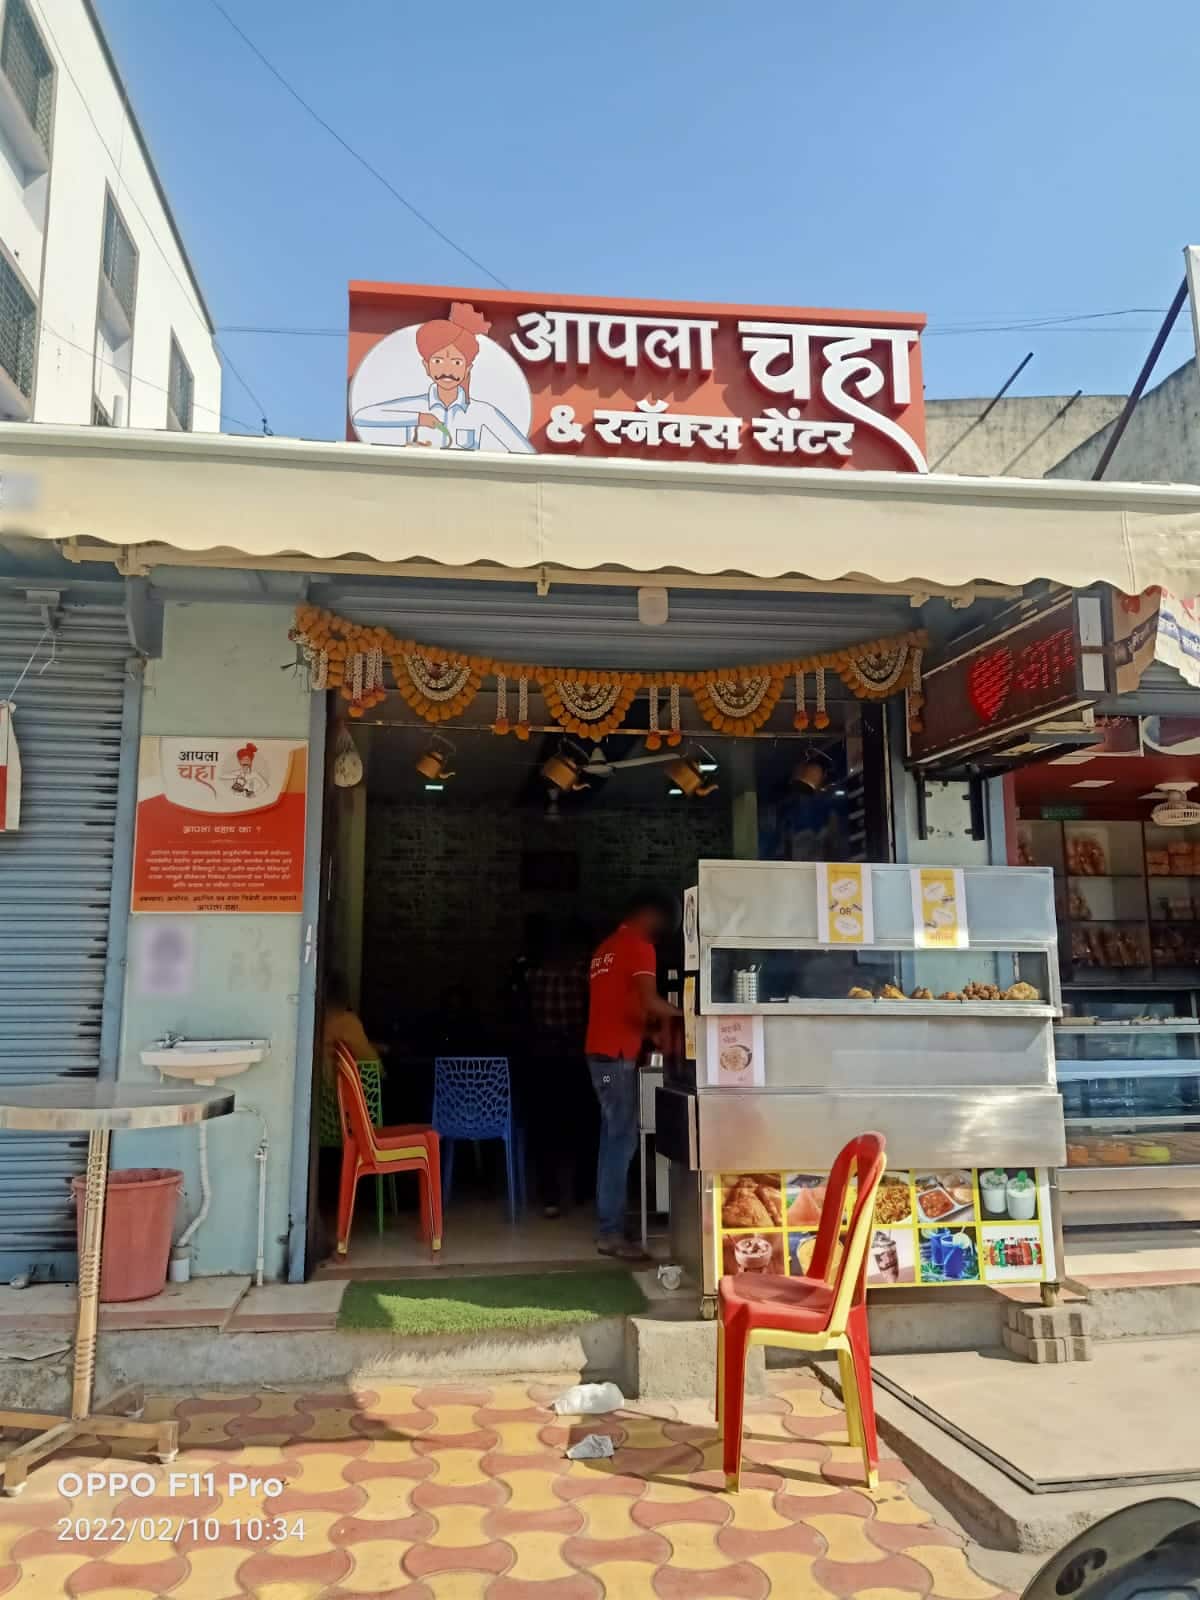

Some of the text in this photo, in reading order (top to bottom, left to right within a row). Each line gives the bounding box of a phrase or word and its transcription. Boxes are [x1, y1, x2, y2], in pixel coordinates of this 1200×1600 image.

[510, 311, 929, 474] आपला चहा
[546, 400, 855, 456] & स्नॅक्स सेंटर
[178, 751, 219, 762] आपला
[176, 764, 217, 800] चहा
[840, 907, 852, 916] OR
